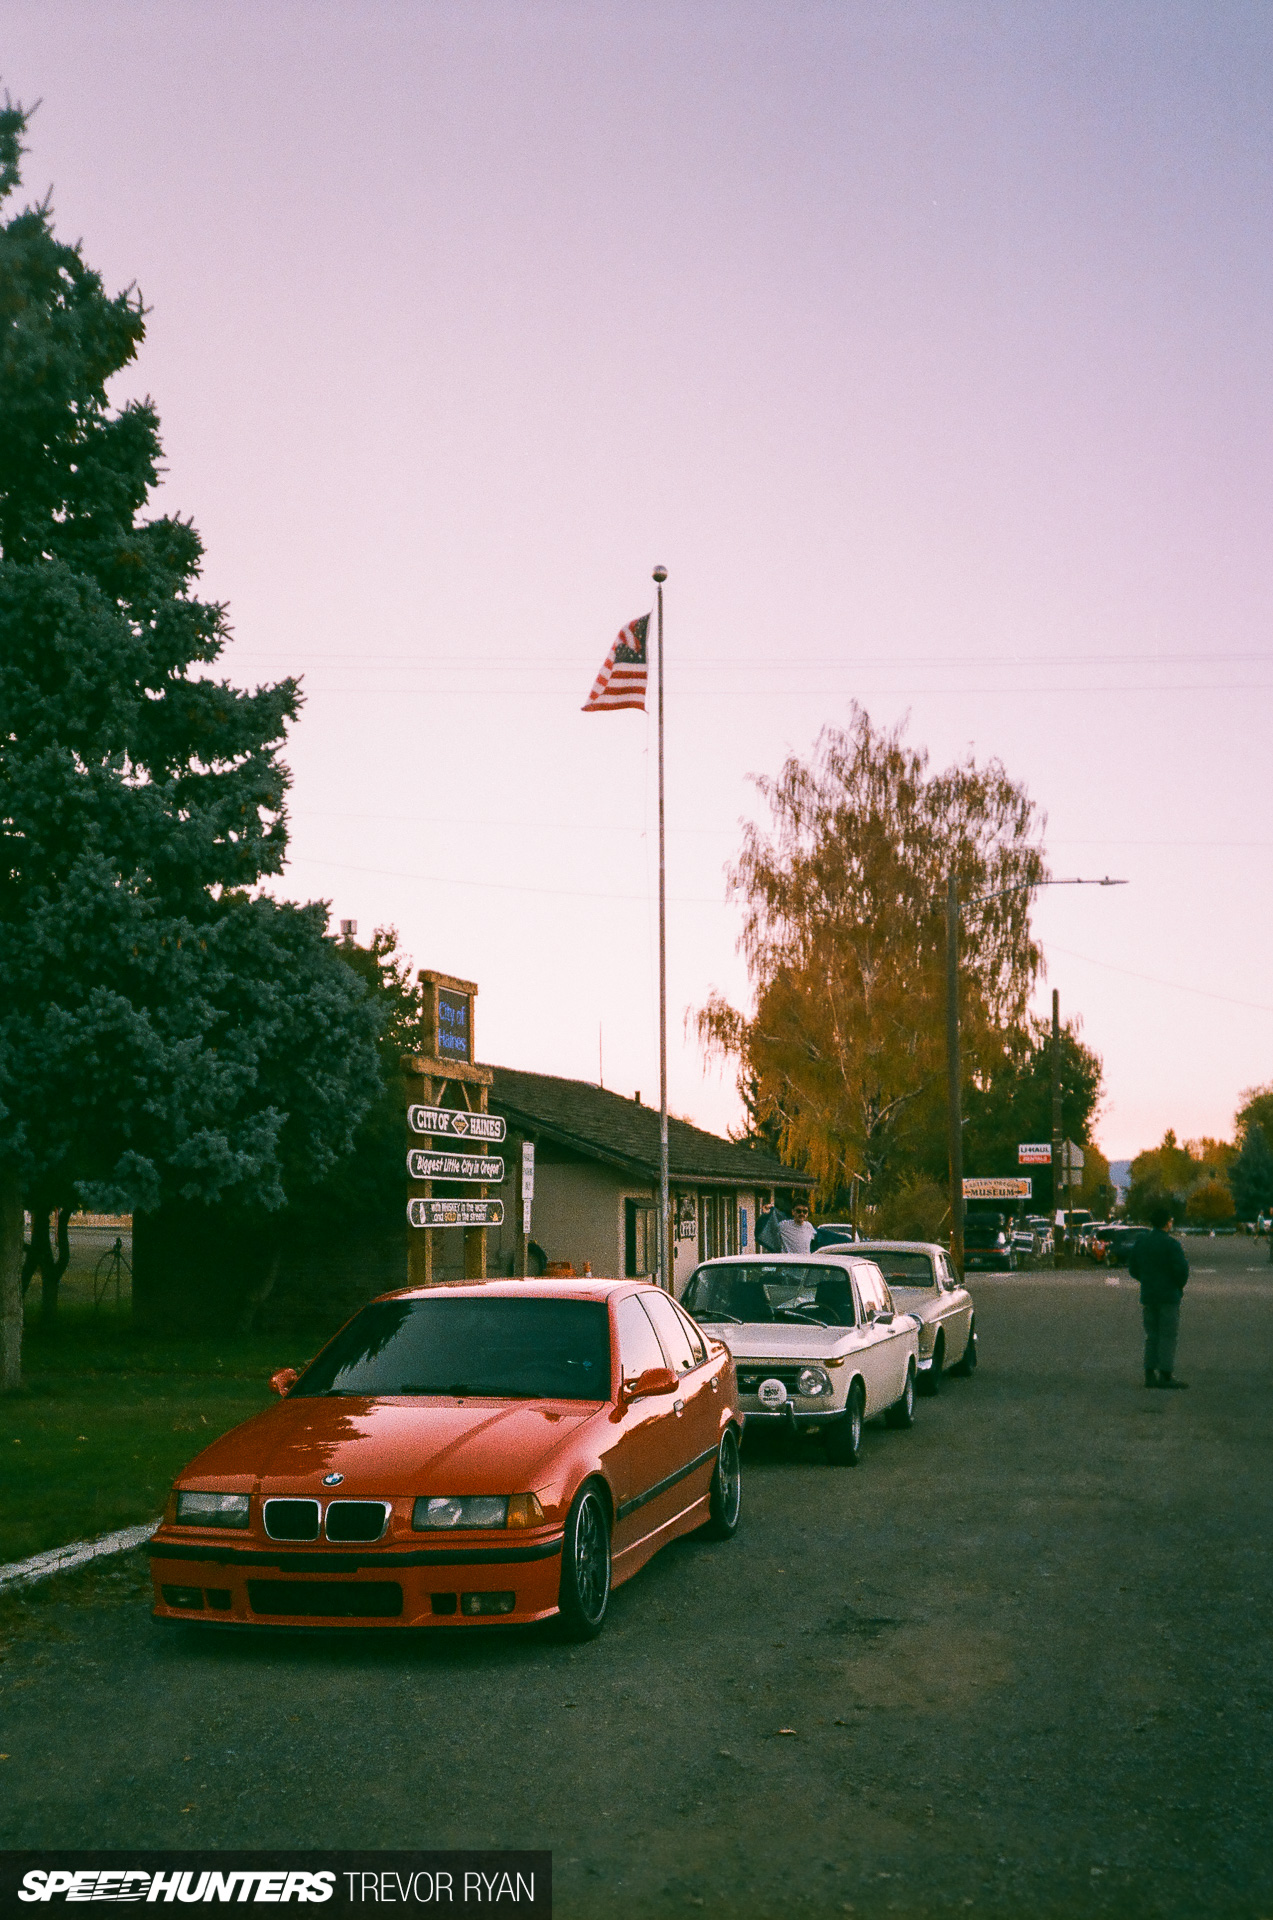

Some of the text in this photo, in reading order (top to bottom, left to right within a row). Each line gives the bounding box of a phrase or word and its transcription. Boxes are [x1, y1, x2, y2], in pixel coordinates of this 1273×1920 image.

[439, 1001, 466, 1026] City of
[438, 1028, 466, 1052] Haines
[417, 1110, 436, 1129] CITY
[438, 1113, 449, 1130] OF
[470, 1118, 500, 1137] HAINES
[443, 1156, 460, 1173] Little
[461, 1159, 474, 1177] City
